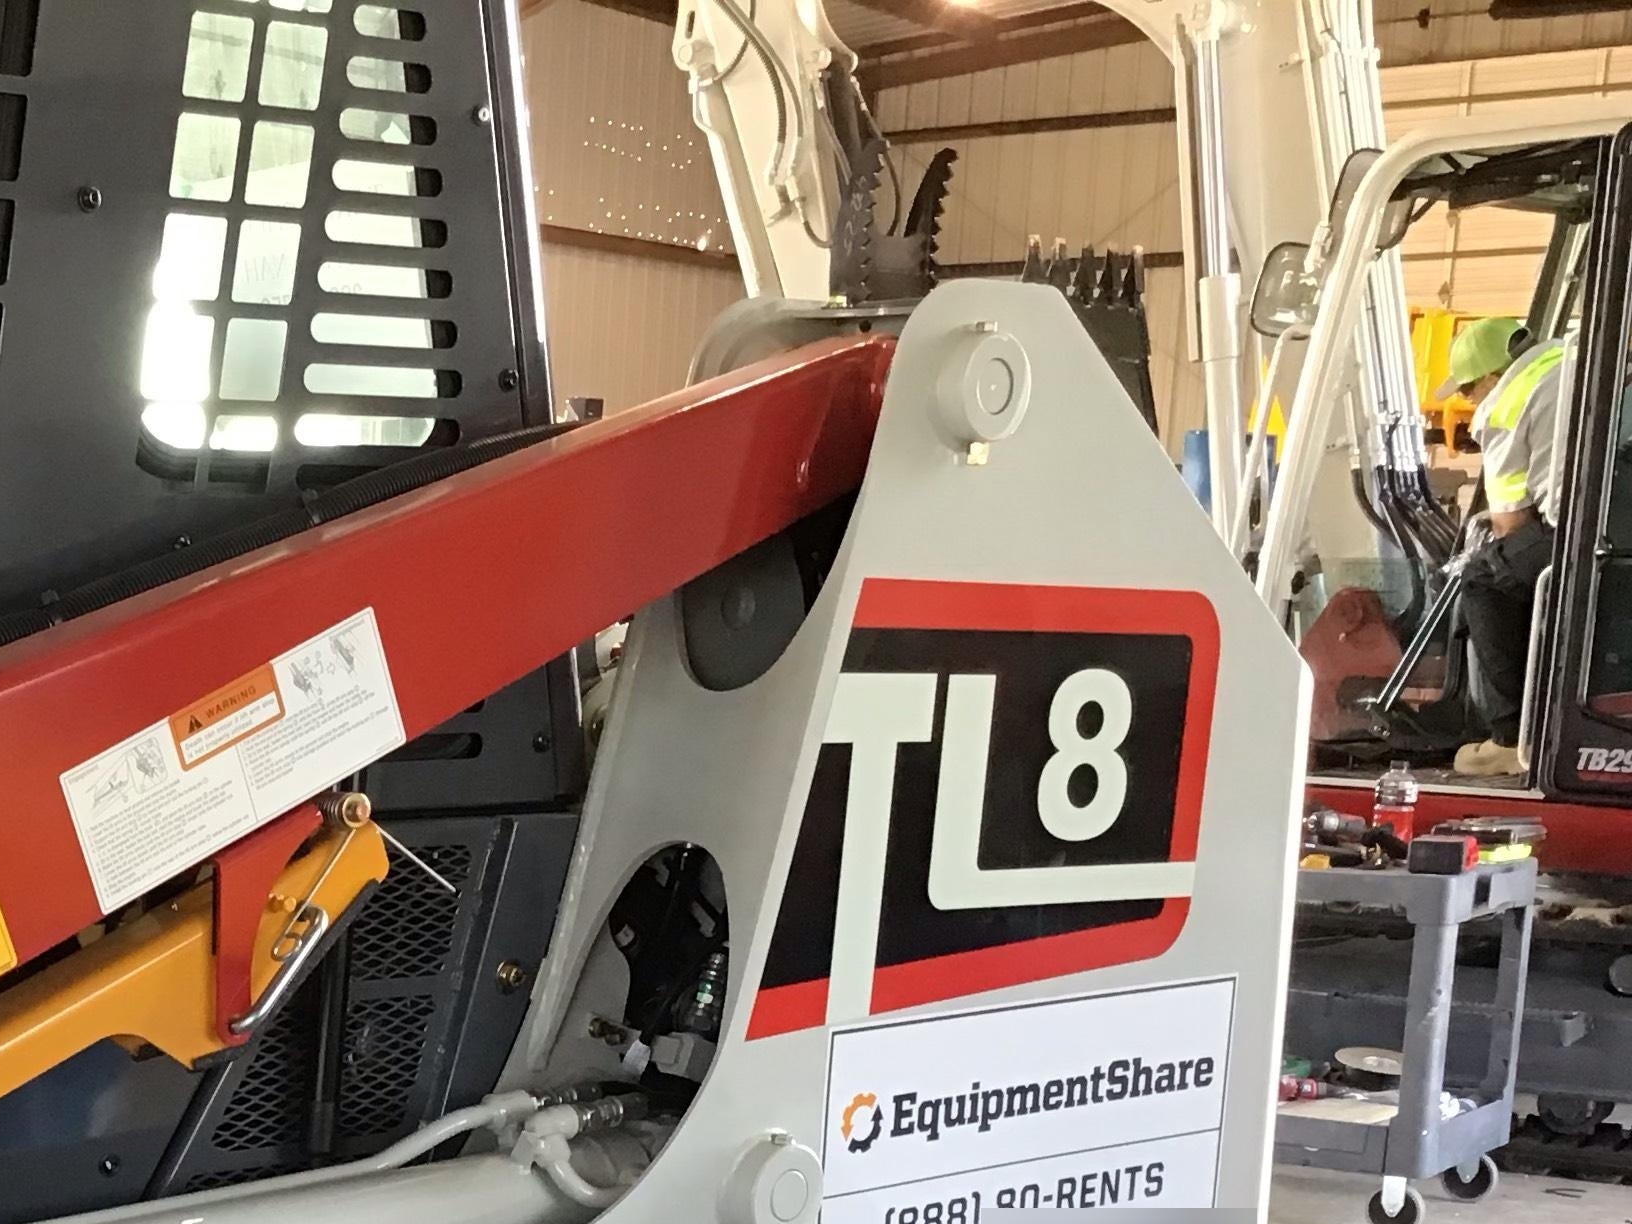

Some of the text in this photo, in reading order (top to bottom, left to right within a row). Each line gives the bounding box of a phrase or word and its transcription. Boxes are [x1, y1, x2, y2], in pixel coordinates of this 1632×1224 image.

[205, 685, 256, 719] WARNING
[820, 667, 1197, 1026] TL8
[890, 1056, 1214, 1141] EquipmentShare
